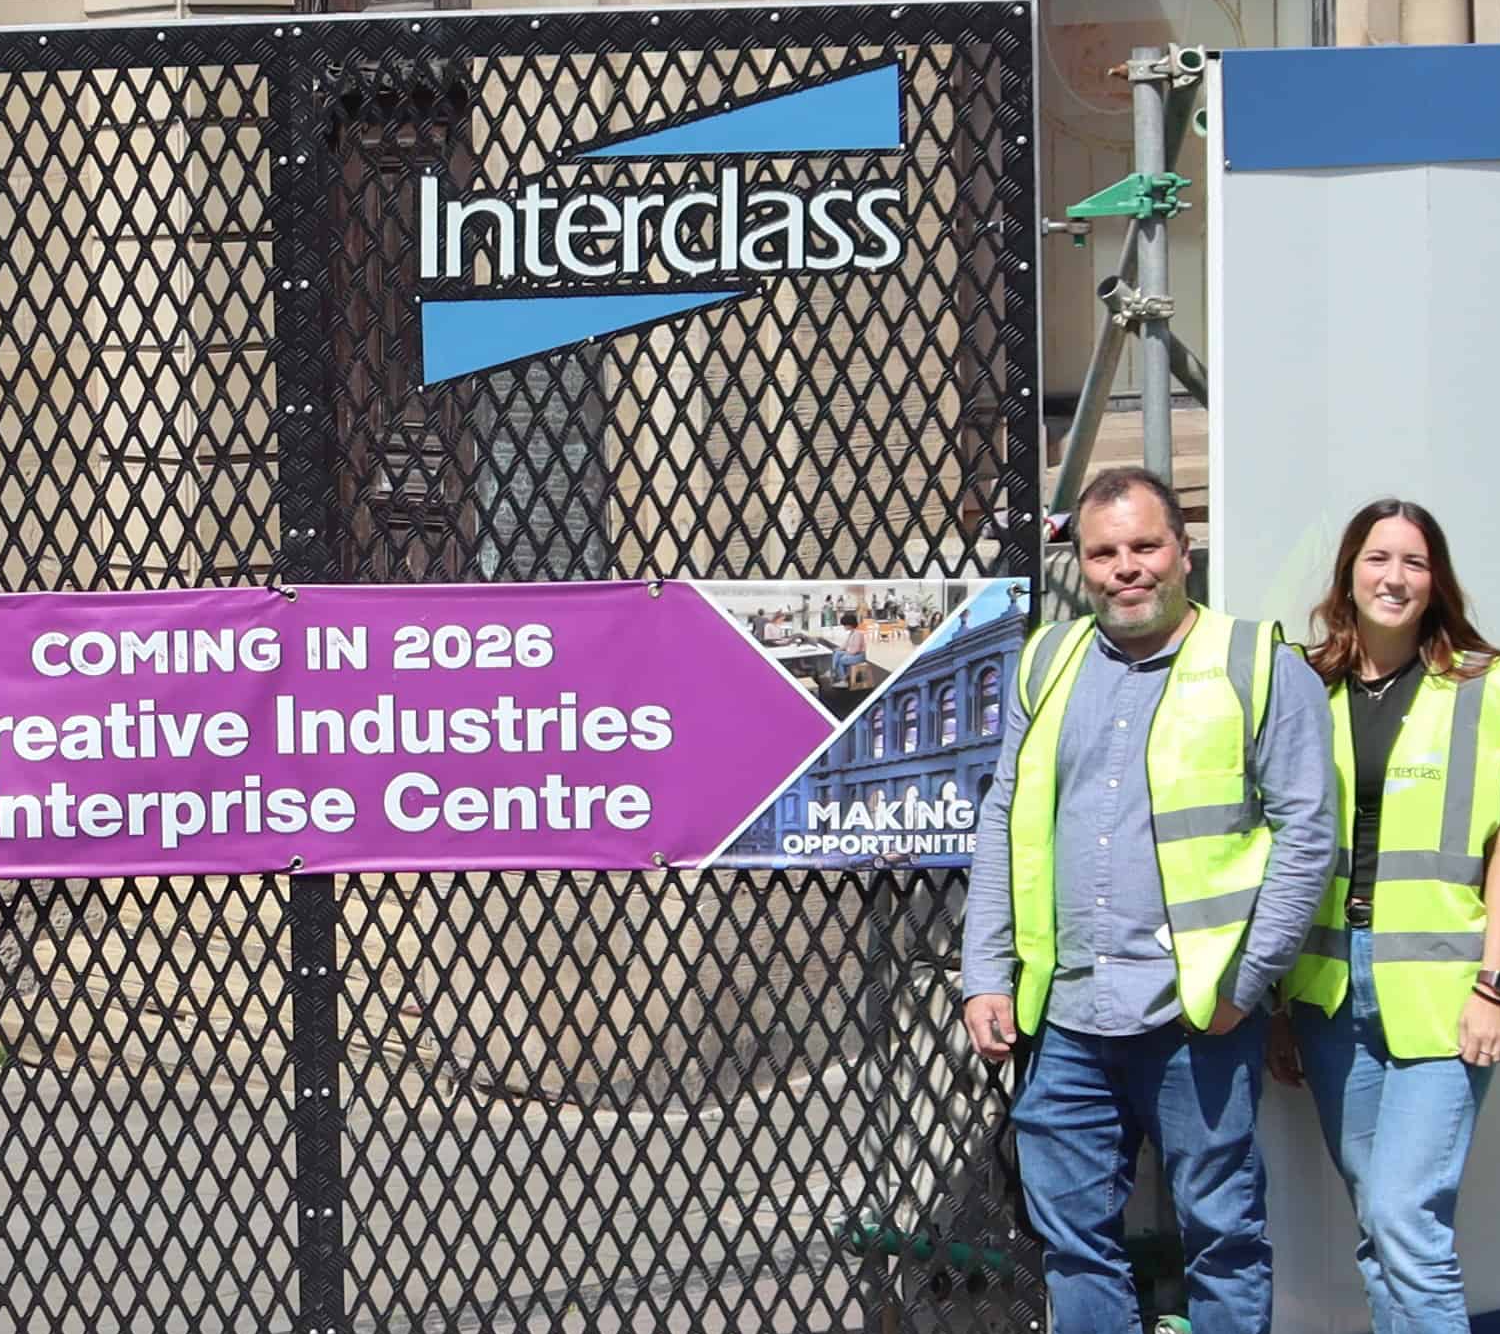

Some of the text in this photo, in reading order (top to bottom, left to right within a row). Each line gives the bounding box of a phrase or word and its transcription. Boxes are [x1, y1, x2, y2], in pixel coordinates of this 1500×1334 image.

[420, 168, 901, 278] Interclass
[32, 624, 554, 677] COMING IN 2026
[276, 692, 673, 755] Industries
[383, 771, 652, 832] Centre
[807, 799, 975, 832] MAKING
[783, 832, 976, 855] OPPORTUNITIE
